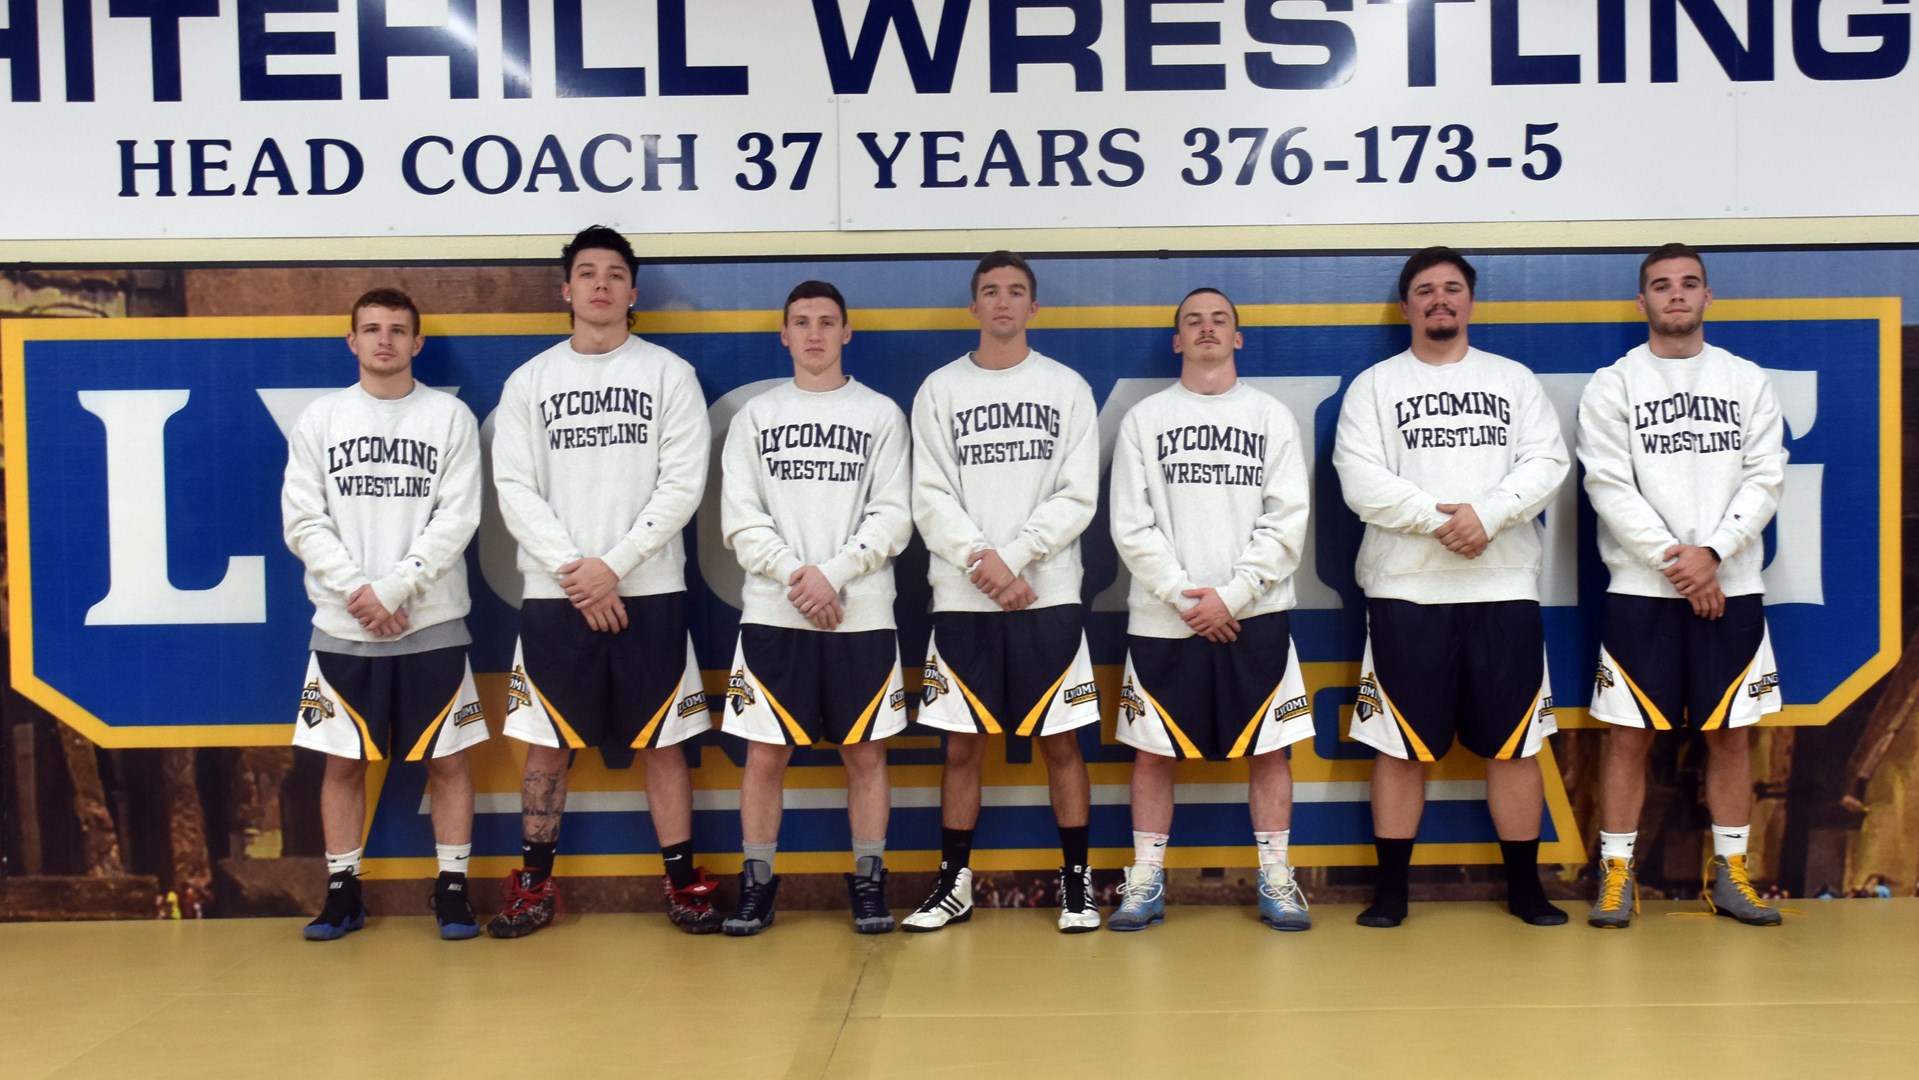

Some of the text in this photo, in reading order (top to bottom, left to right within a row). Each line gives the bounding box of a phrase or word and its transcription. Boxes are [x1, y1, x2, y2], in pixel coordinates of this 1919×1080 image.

[812, 0, 1912, 94] WRESTLING
[117, 122, 1564, 198] HEAD COACH 37 YEARS 376-173-5
[540, 386, 653, 428] LYCOMING
[1395, 391, 1511, 429] LYCOMING
[1635, 392, 1741, 431] LYCOMING
[328, 436, 438, 475] LYCOMING
[548, 423, 648, 450] WRESTLING
[1401, 425, 1507, 450] WRESTLING
[1640, 430, 1741, 454] WRESTLING
[335, 475, 431, 498] WRESTLING
[1161, 462, 1263, 487] WRESTLING
